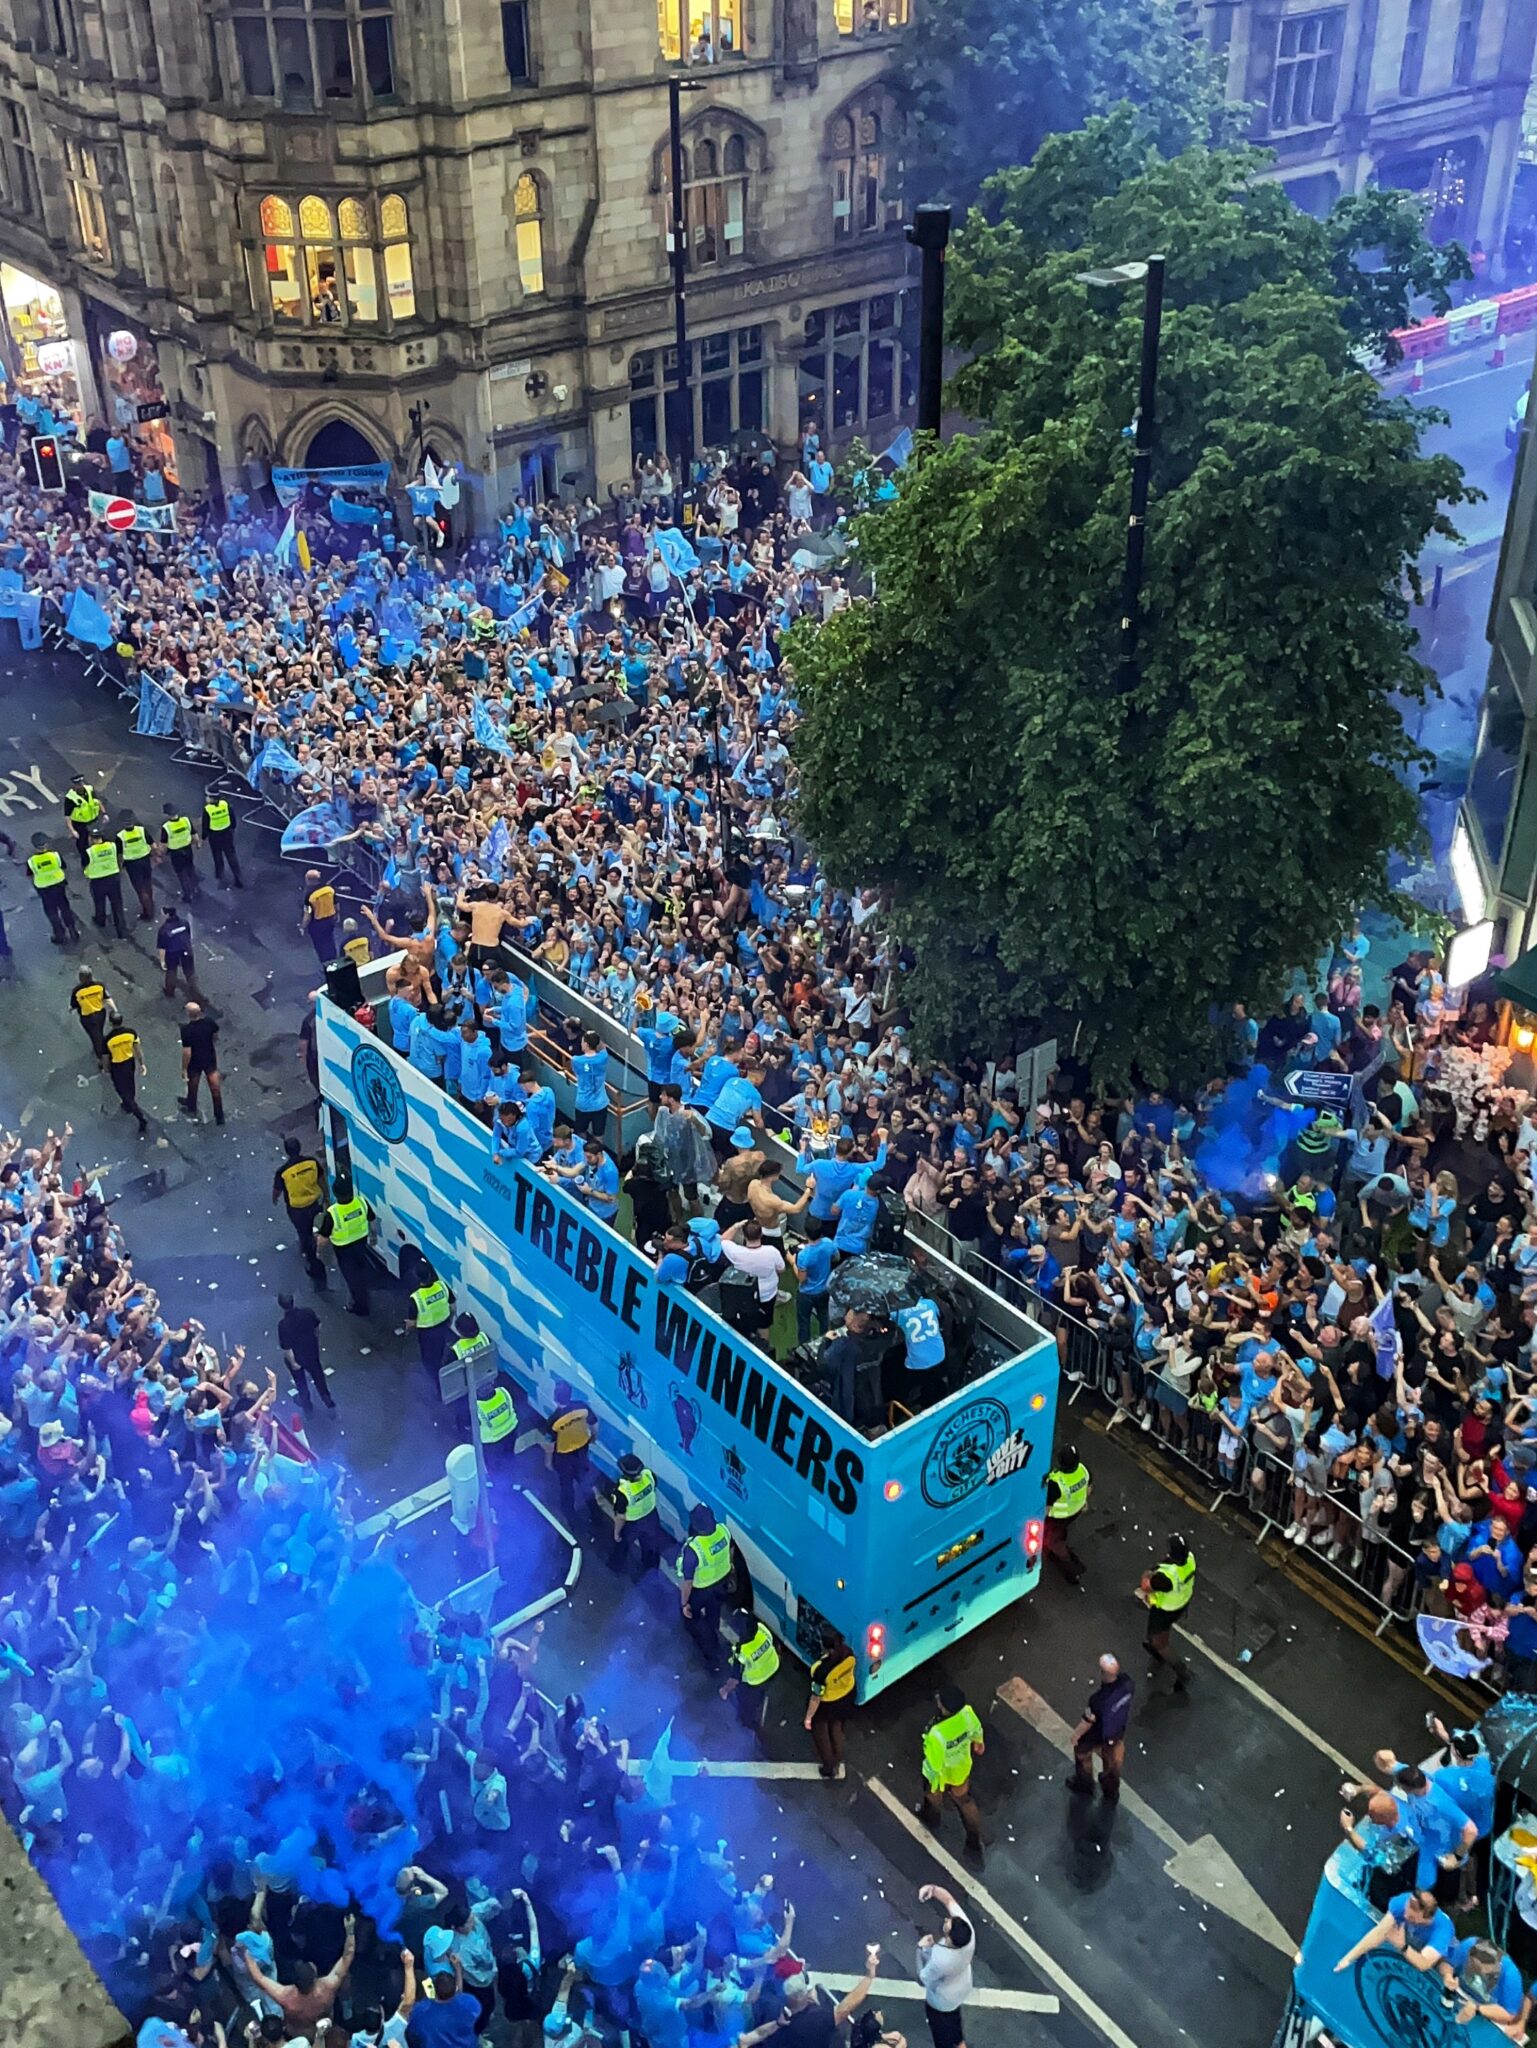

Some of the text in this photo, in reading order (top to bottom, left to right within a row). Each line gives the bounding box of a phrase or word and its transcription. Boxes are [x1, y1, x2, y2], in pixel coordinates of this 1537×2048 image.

[415, 490, 428, 504] 16
[513, 1171, 864, 1515] TREBLE WINNERS
[906, 1309, 938, 1343] 23
[932, 1406, 1002, 1460] MANCHESTER
[951, 1478, 979, 1498] CITY
